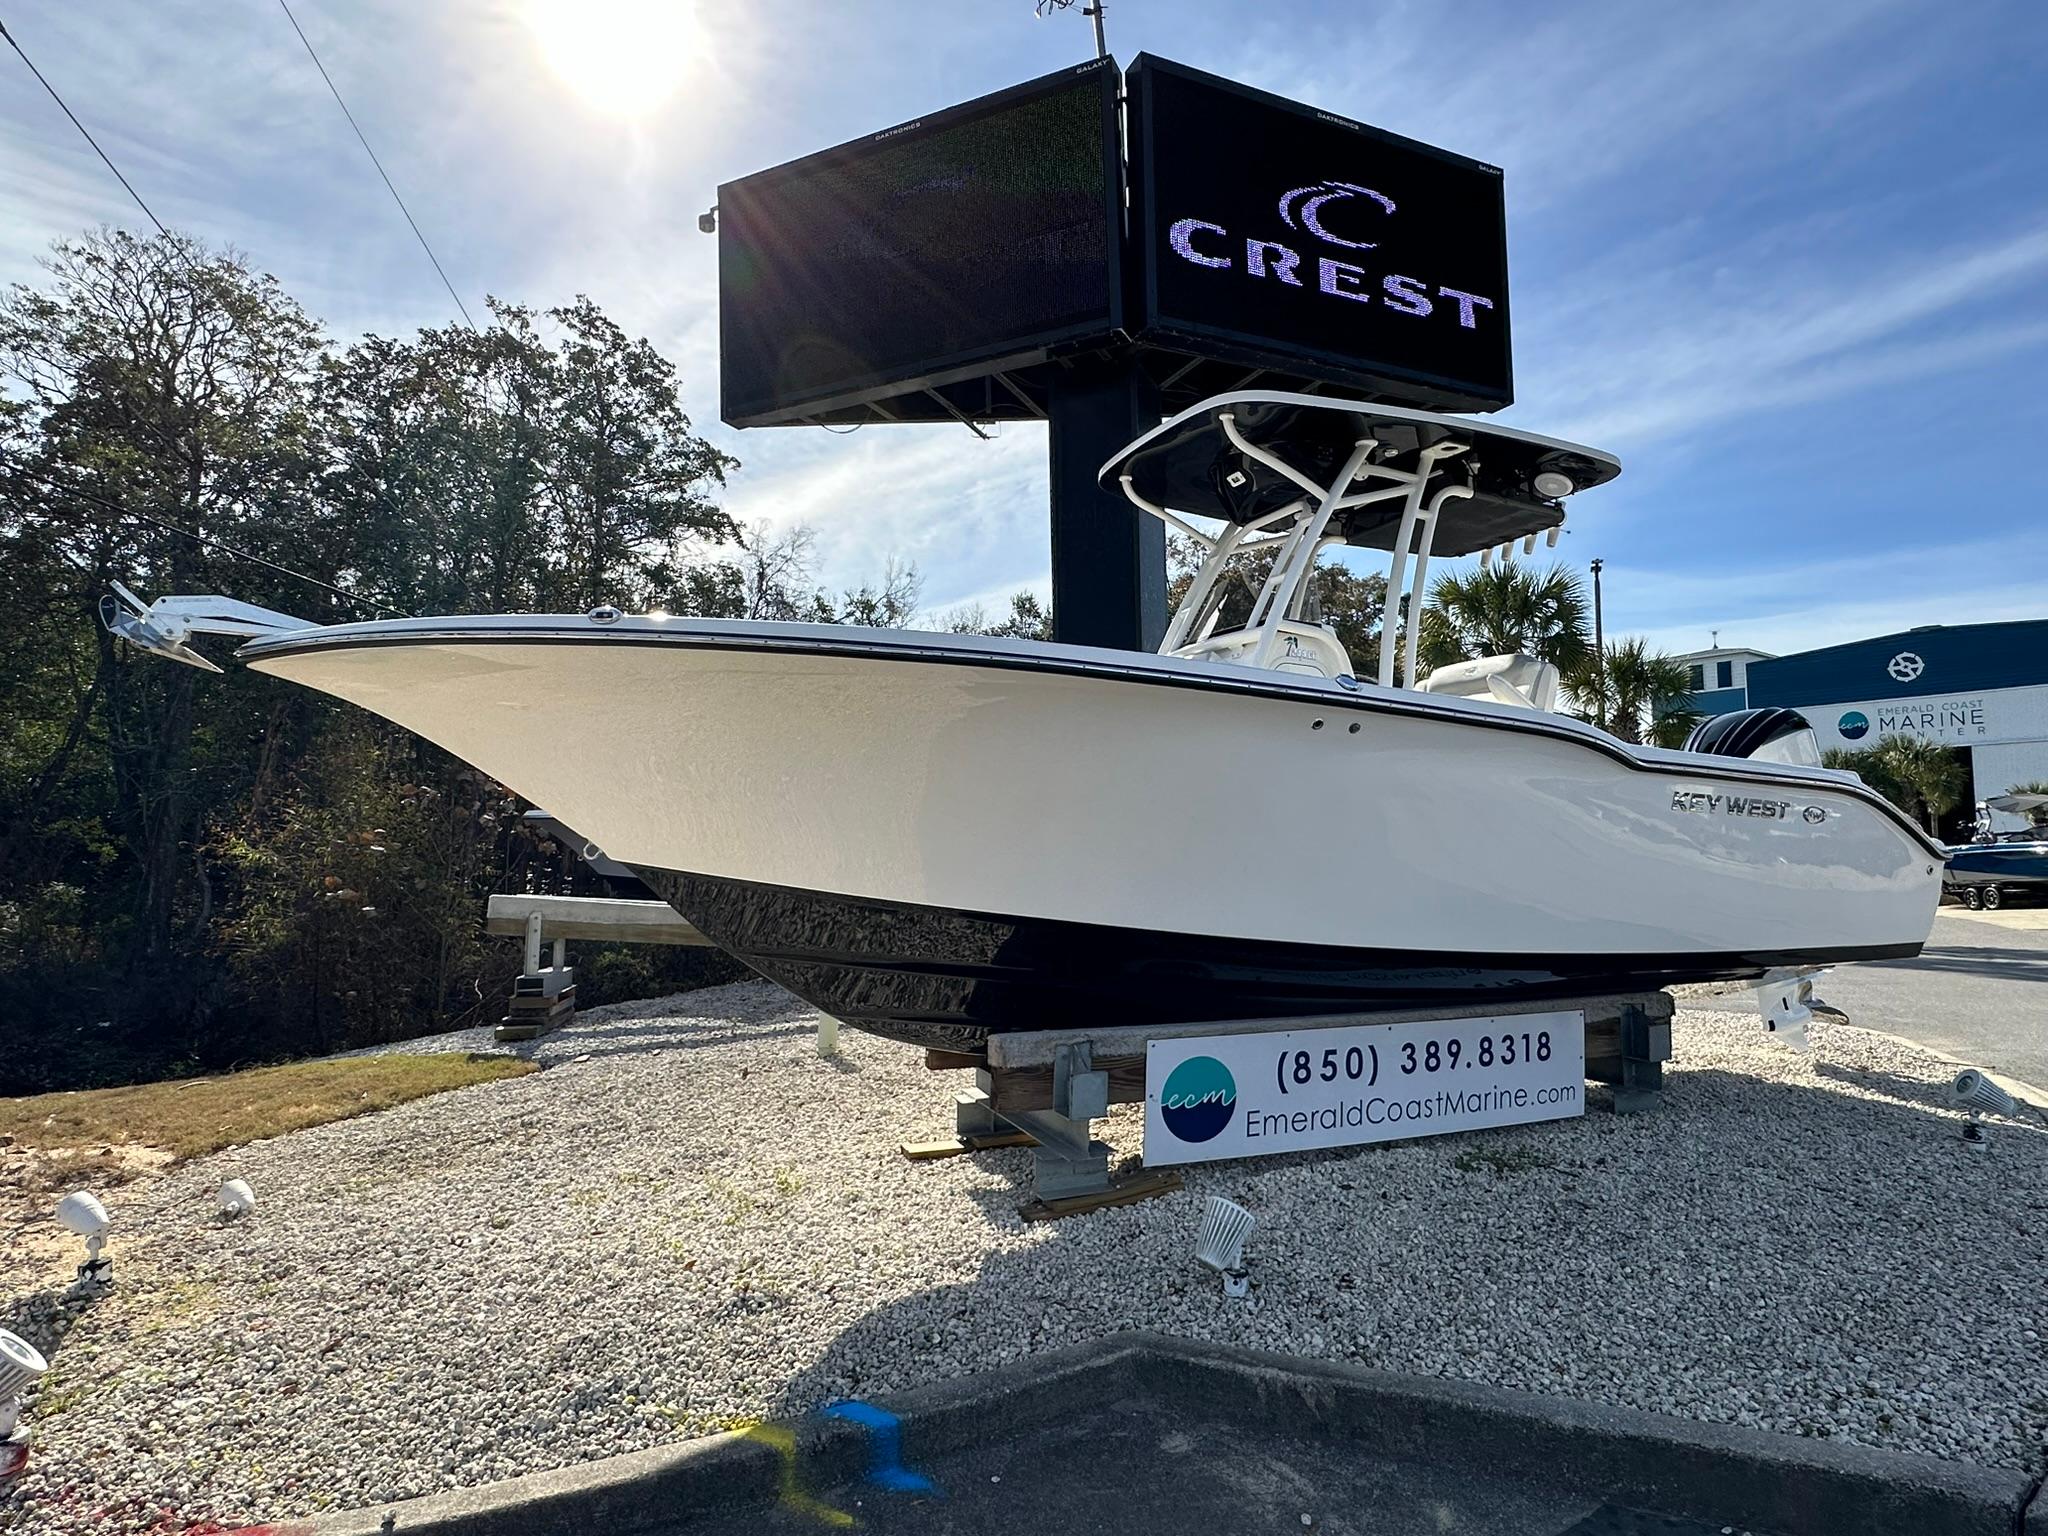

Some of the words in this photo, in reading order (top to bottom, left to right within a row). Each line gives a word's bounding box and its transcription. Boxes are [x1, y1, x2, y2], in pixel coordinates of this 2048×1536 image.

[1076, 58, 1110, 74] GALAXY
[874, 121, 921, 141] DAKTRONICS
[1169, 218, 1493, 329] CREST
[1877, 704, 1934, 716] EMERALD
[1942, 700, 1984, 711] COAST
[1879, 709, 1985, 731] MARINE
[1671, 791, 1722, 814] KEY
[1726, 796, 1791, 819] WEST
[1276, 1044, 1379, 1095] (850)
[1400, 1031, 1552, 1075] 389.8318
[1161, 1090, 1237, 1110] ecm
[1246, 1084, 1576, 1138] EmeraldCoastMarine.com
